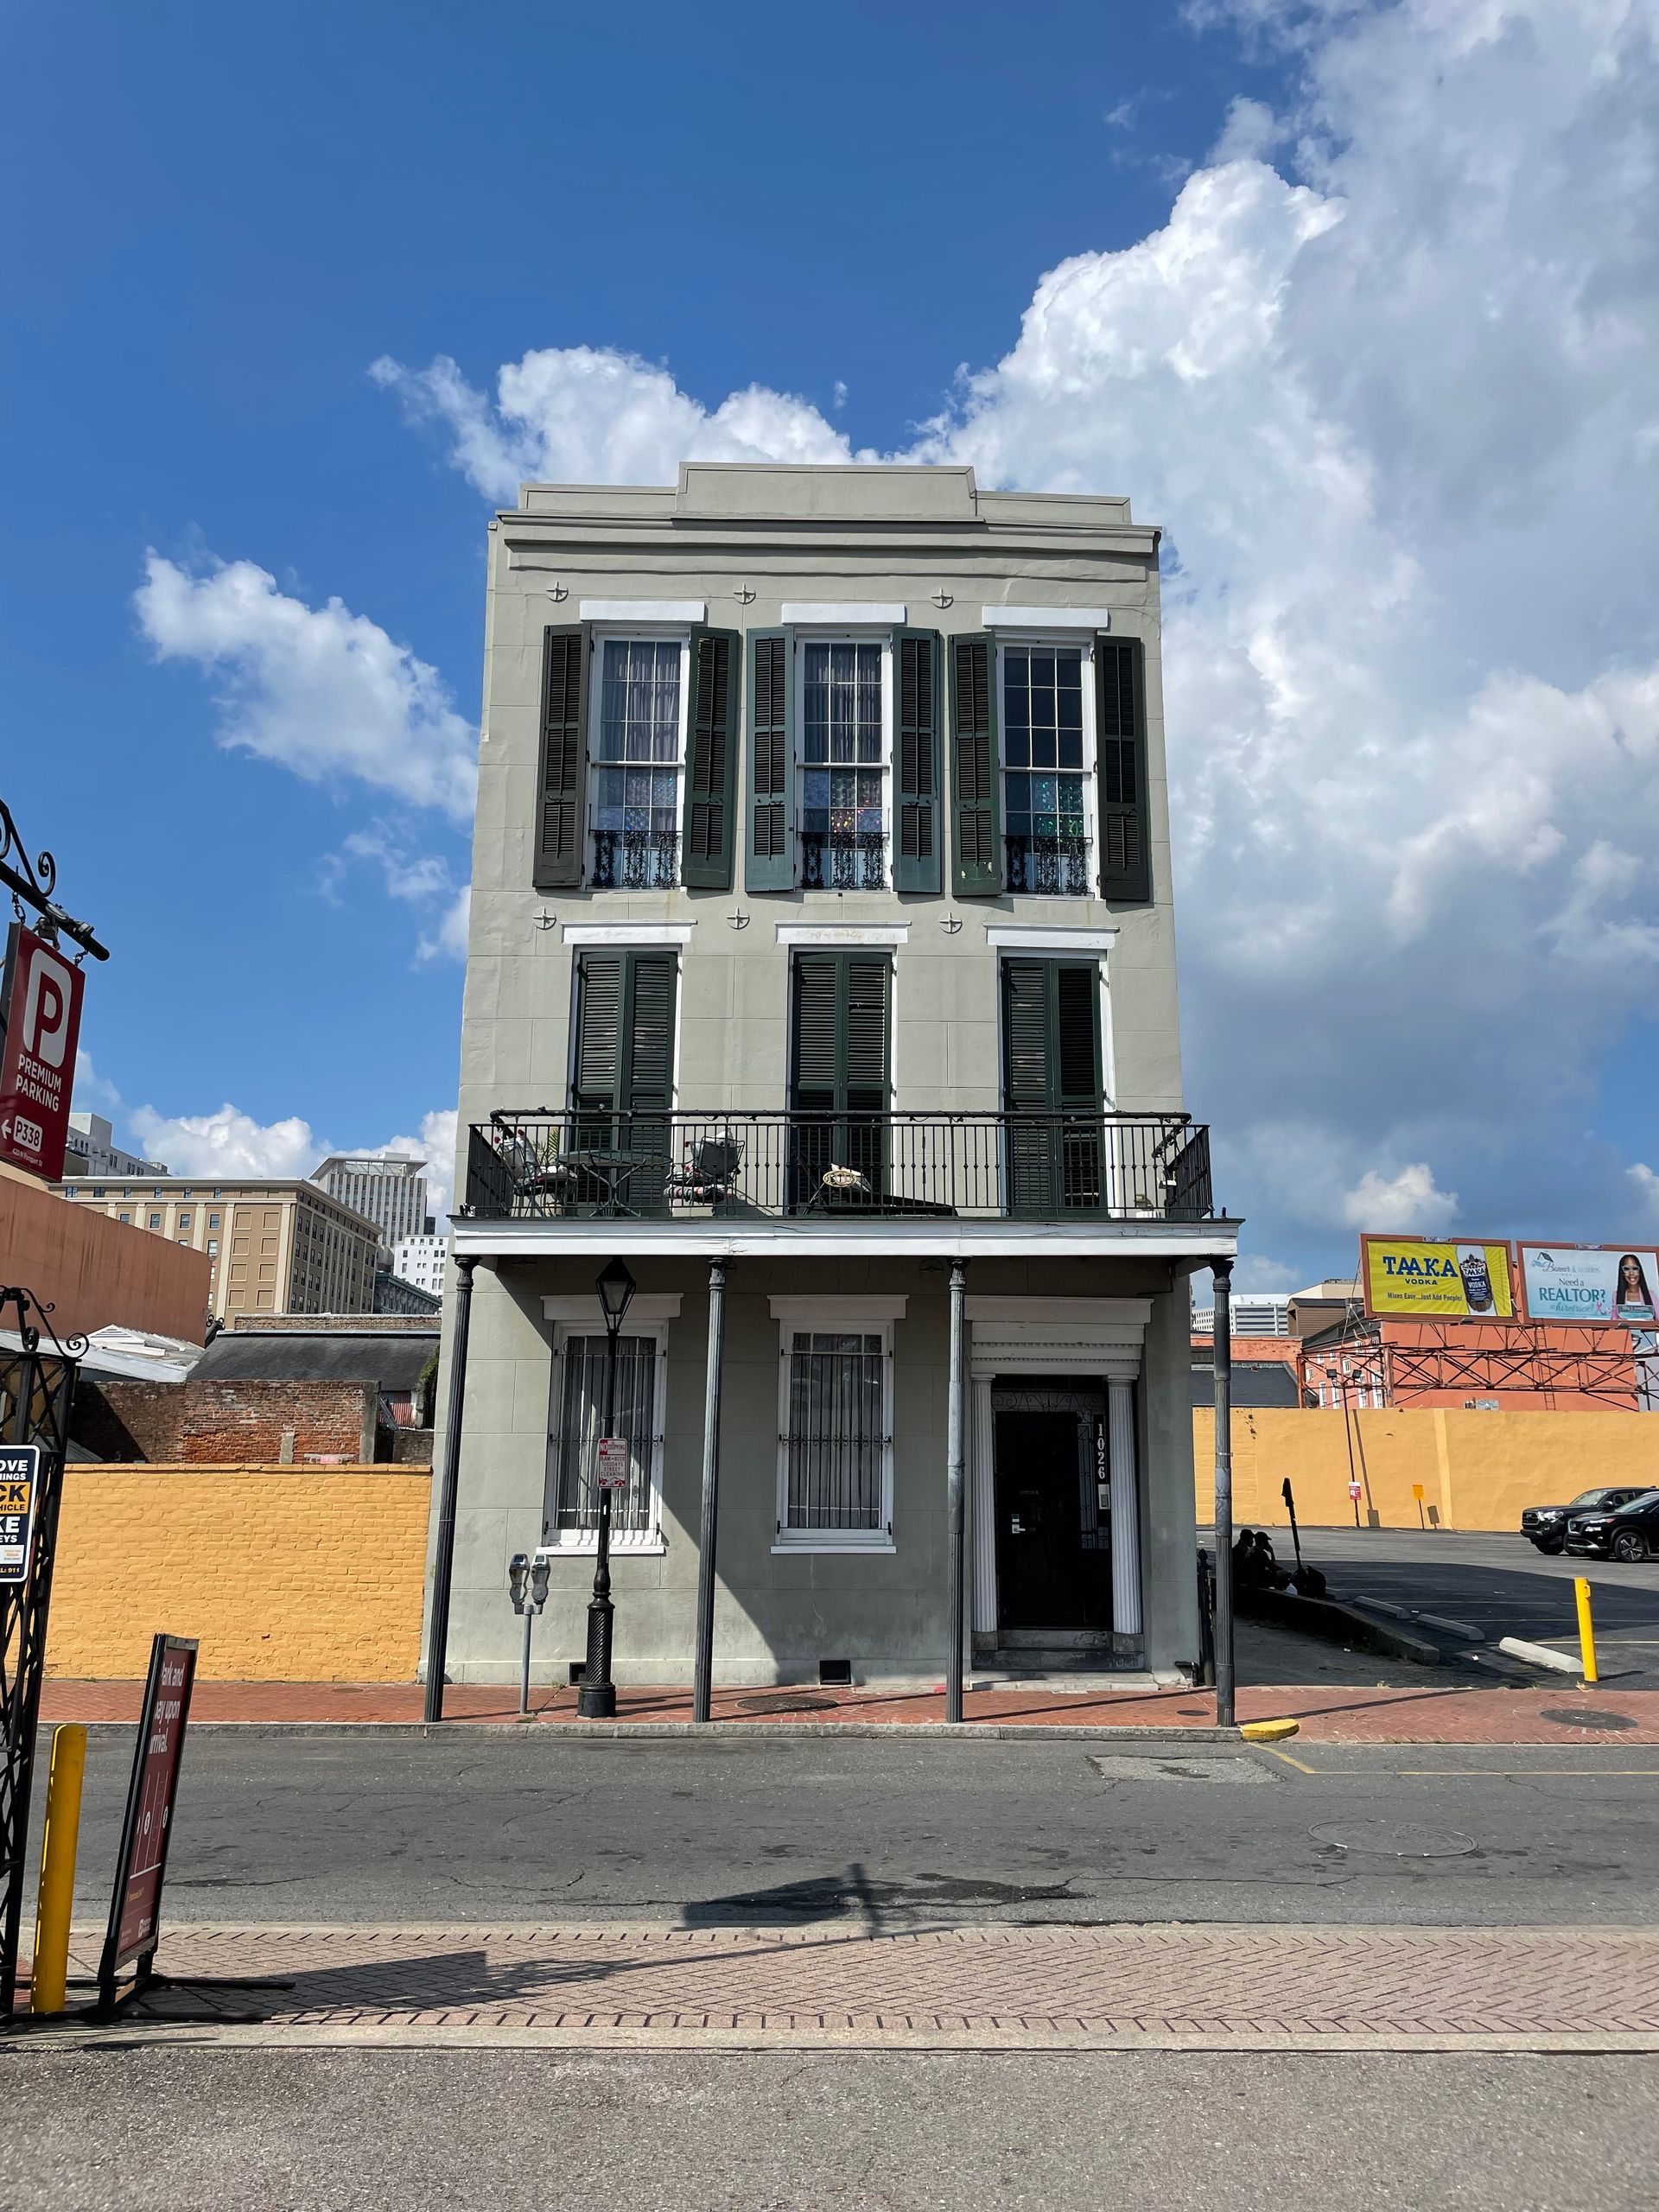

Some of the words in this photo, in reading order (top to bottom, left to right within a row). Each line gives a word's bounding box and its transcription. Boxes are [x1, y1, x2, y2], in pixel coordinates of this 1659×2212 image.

[18, 1053, 61, 1093] PREMIUM
[16, 1074, 59, 1111] PARKING
[16, 1121, 40, 1147] P338
[1382, 1256, 1458, 1277] TAAKA
[1539, 1287, 1605, 1302] REALTOR?
[172, 1662, 185, 1687] and
[165, 1700, 181, 1724] upon
